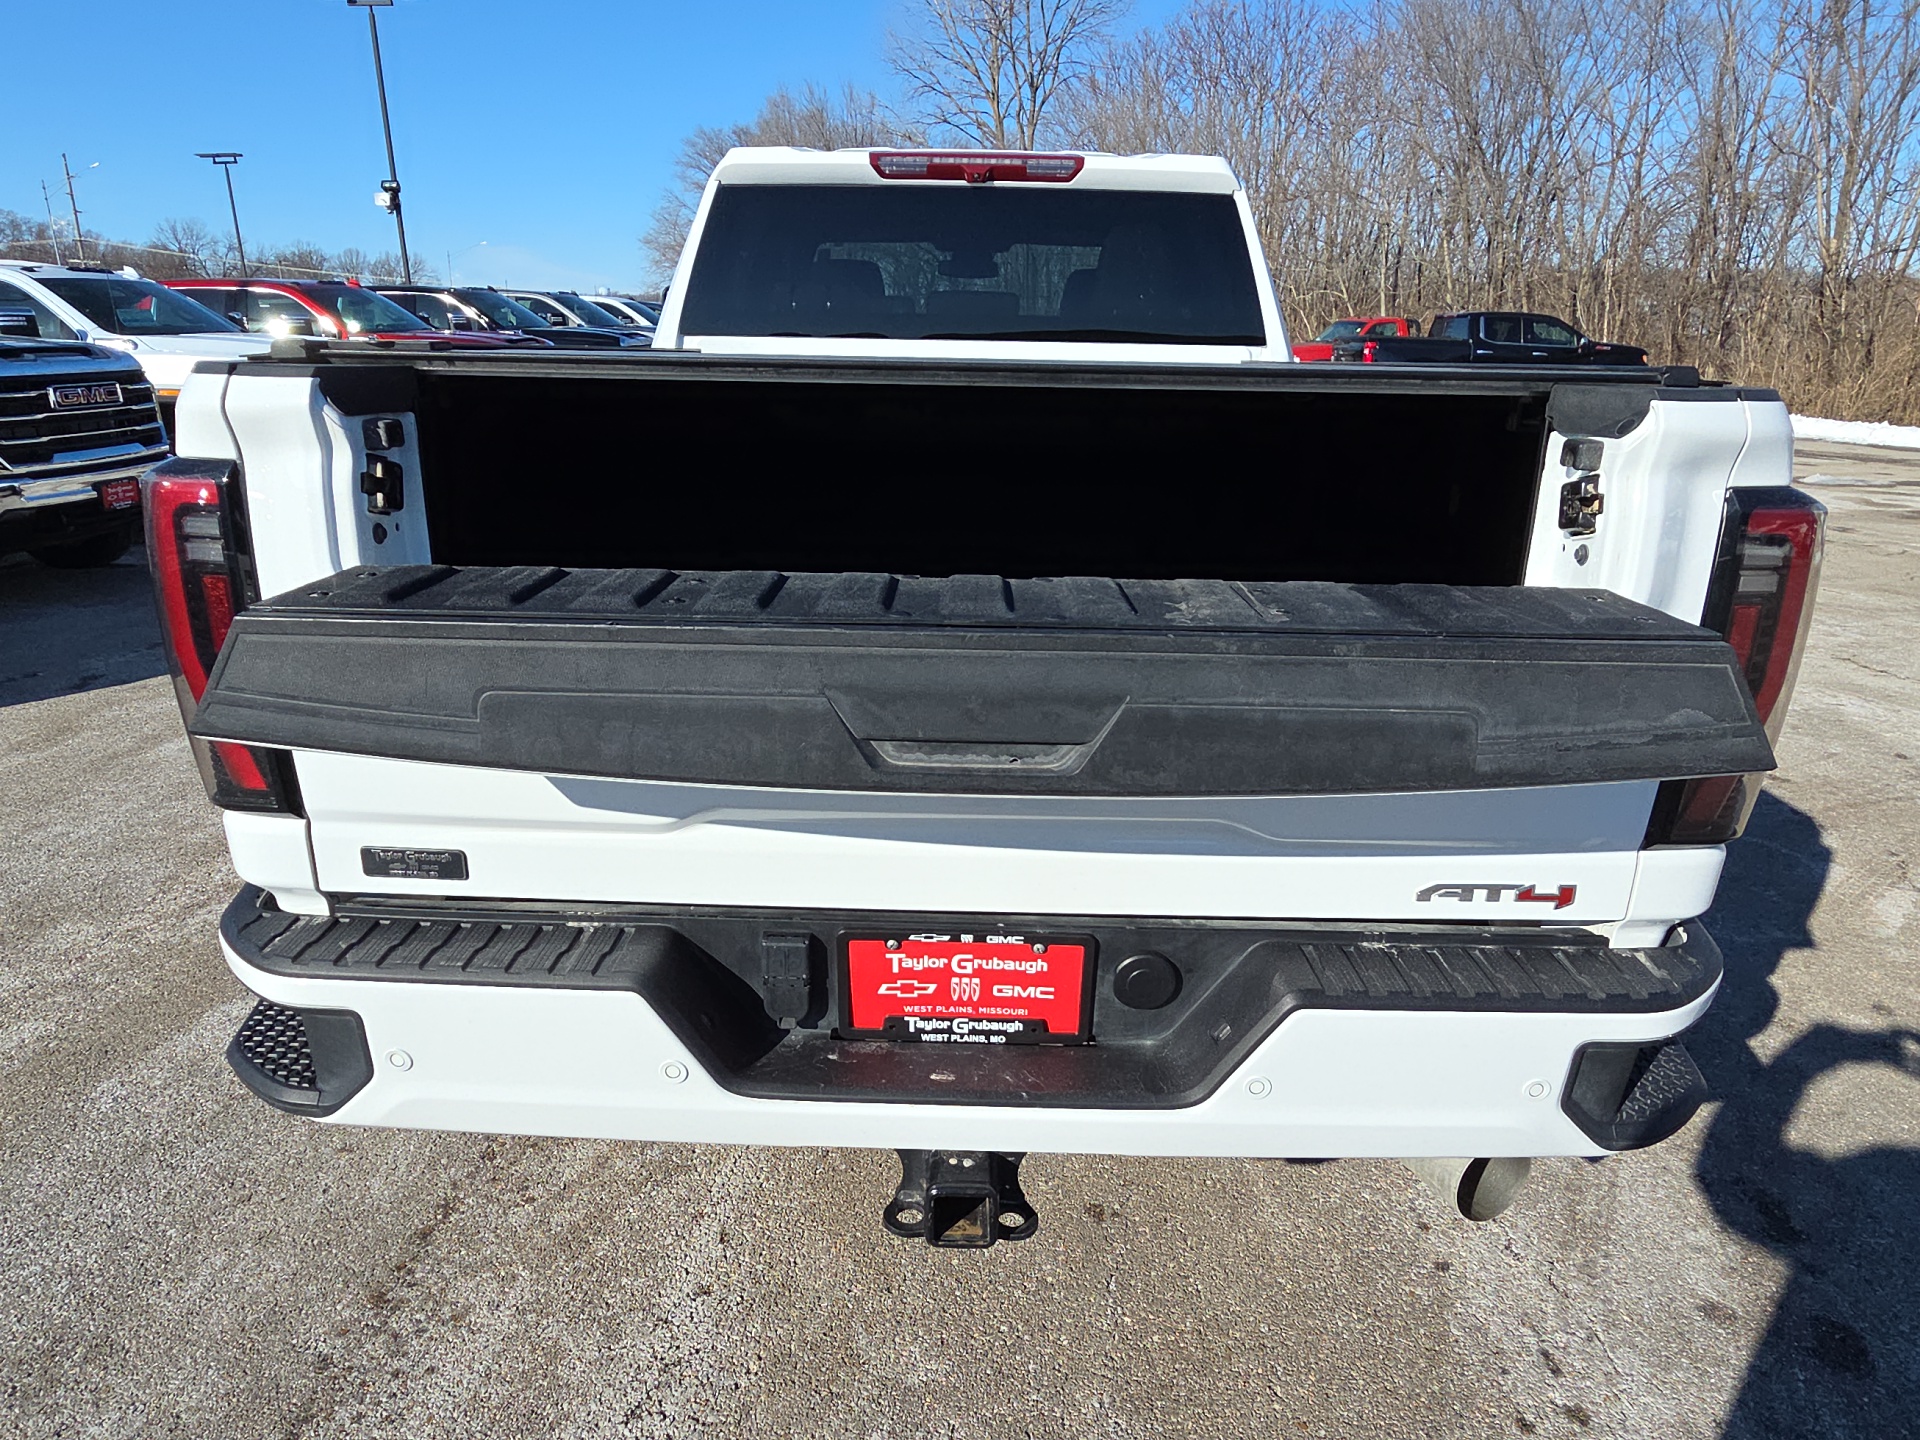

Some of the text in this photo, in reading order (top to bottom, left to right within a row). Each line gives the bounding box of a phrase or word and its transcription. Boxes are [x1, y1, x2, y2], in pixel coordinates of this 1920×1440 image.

[57, 386, 119, 405] GMC
[370, 849, 452, 863] Taylor Grubaugh
[1416, 884, 1578, 911] AT4
[986, 935, 1025, 945] GMC
[885, 953, 1048, 974] Taylor Grubaugh
[992, 984, 1055, 1000] GMC
[903, 1005, 1029, 1016] WEST PLAINS, MISSOURI
[903, 1016, 1024, 1034] Taylor Grubaugh
[920, 1033, 1007, 1044] WEST PLAINS, MO
